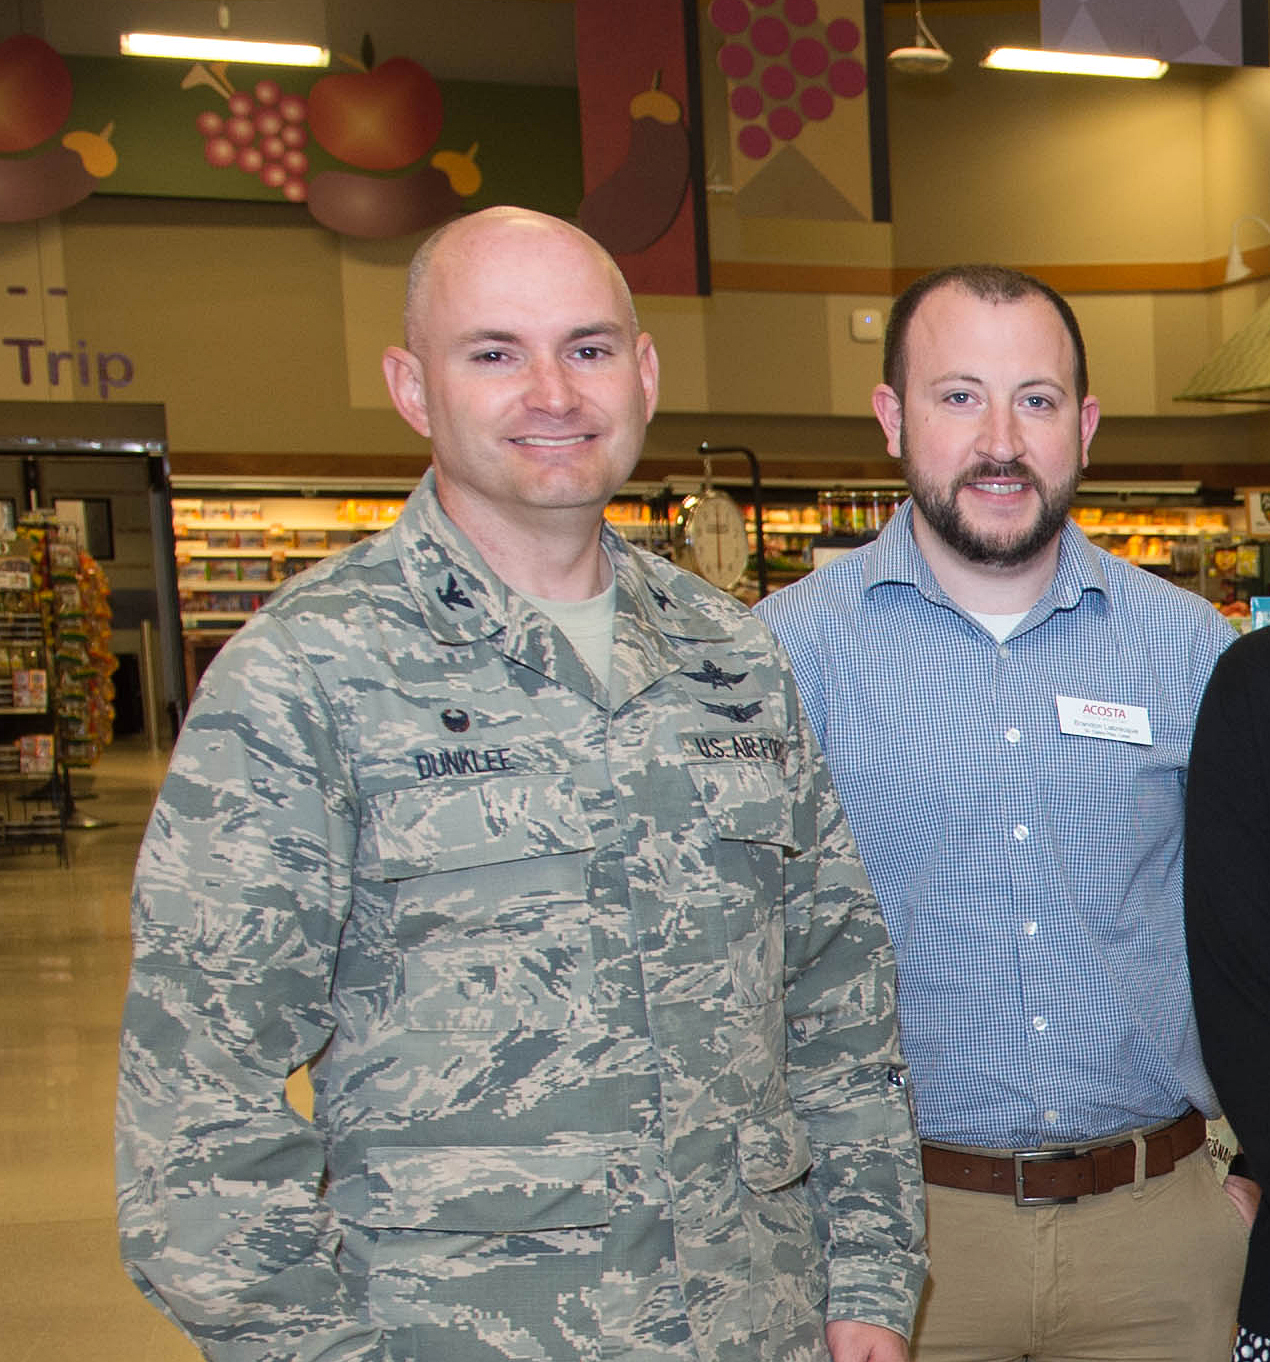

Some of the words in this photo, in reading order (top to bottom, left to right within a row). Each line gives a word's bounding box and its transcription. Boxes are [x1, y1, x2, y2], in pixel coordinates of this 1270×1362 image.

[3, 338, 134, 399] Trip
[1083, 704, 1126, 719] ACOSTA
[732, 736, 761, 758] AIR
[416, 748, 516, 780] DUNKLEE
